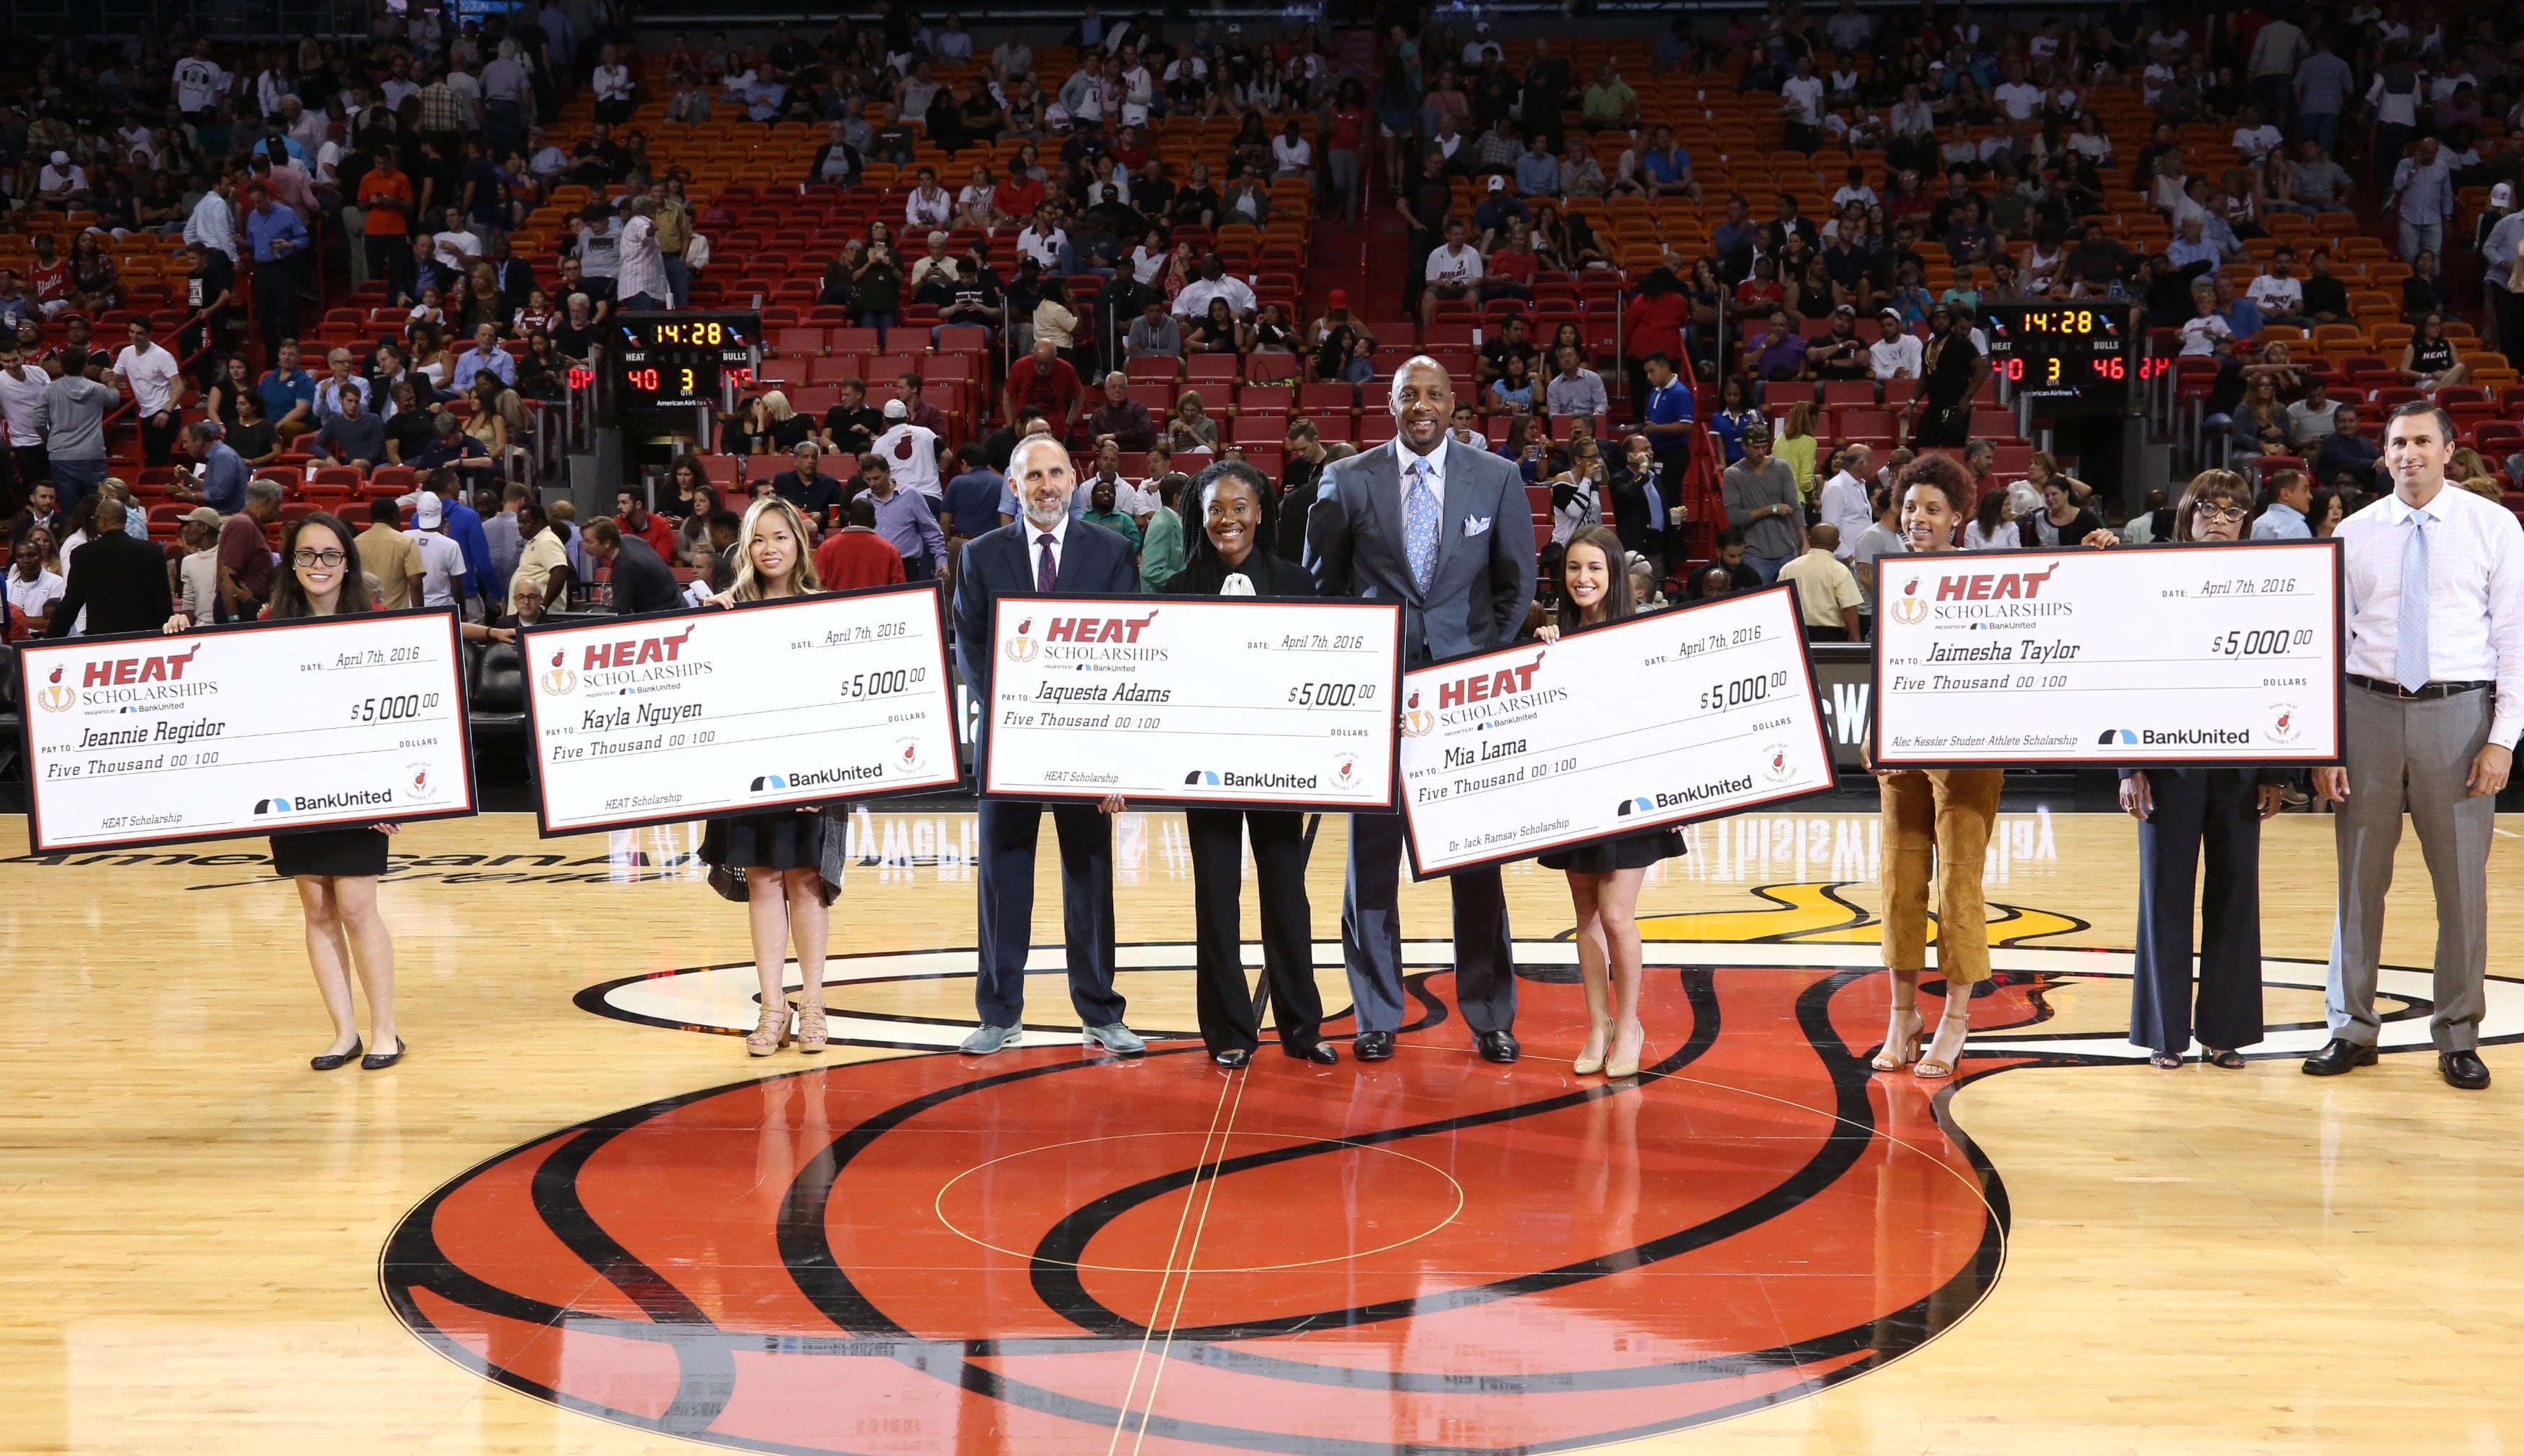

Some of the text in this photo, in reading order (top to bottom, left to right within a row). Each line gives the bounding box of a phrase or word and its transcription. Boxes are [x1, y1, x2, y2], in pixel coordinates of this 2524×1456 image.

[37, 276, 63, 296] Bulls
[2025, 311, 2092, 333] 14:28
[657, 323, 721, 345] 14:28
[2094, 341, 2119, 350] BULLS
[2423, 350, 2448, 360] HEAT
[628, 369, 658, 391] 40
[681, 369, 693, 390] 3
[2048, 358, 2060, 380] 3
[2092, 358, 2125, 380] 46
[1935, 561, 2059, 601] HEAT
[2162, 589, 2188, 598] DATE:
[2200, 580, 2232, 597] April
[2261, 578, 2296, 593] 2016
[1935, 602, 2073, 619] SCHOLARSHIPS
[791, 640, 814, 650] DATE:
[825, 628, 851, 645] April
[877, 622, 906, 638] 2016
[1045, 609, 1159, 644] HEAT
[1989, 622, 2036, 630] BankUnited
[583, 622, 695, 671] HEAT
[1281, 634, 1309, 650] April
[1333, 635, 1363, 649] 2016
[1644, 655, 1669, 667] DATE:
[1679, 637, 1704, 658] April
[1732, 625, 1761, 645] 2016
[1925, 640, 2012, 663] Jaimesha
[2020, 639, 2081, 665] Taylor
[300, 663, 324, 672] DATE:
[335, 651, 363, 668] April
[390, 646, 420, 662] 2016
[1045, 646, 1168, 661] SCHOLARSHIPS
[82, 642, 201, 688] HEAT
[584, 661, 713, 688] SCHOLARSHIPS
[1093, 664, 1135, 673] BankUnited
[637, 682, 681, 693] BankUnited
[1439, 650, 1545, 710] HEAT
[1892, 675, 1925, 690] Five
[1933, 674, 2010, 689] Thousand
[2263, 678, 2307, 686] DOLLARS
[82, 681, 218, 706] SCHOLARSHIPS
[1035, 681, 1108, 704] Jaquesta
[1111, 682, 1171, 703] Adams
[138, 701, 184, 712] BankUnited
[581, 706, 630, 732] Kayla
[636, 702, 702, 727] Nguyen
[888, 711, 925, 723] DOLLARS
[1440, 687, 1568, 727] SCHOLARSHIPS
[1003, 711, 1034, 726] Five
[1040, 712, 1110, 728] Thousand
[1494, 711, 1538, 727] BankUnited
[1753, 717, 1792, 732] DOLLARS
[60, 744, 75, 752] TO:
[78, 725, 148, 748] Jeannie
[153, 717, 226, 744] Regidor
[399, 737, 437, 748] DOLLARS
[1891, 734, 2078, 747] Alec Kessler Student-Athlete Scholarship
[2143, 729, 2250, 745] BankUnited
[552, 745, 584, 760] Five
[590, 734, 663, 756] Thousand
[47, 763, 81, 778] Five
[88, 754, 164, 775] Thousand
[1409, 739, 1527, 779] PAY TO: Mia Lama
[789, 763, 883, 788] BankUnited
[1044, 770, 1119, 785] HEAT Scholarship
[1224, 772, 1317, 789] BankUnited
[1419, 786, 1448, 802] Five
[1454, 765, 1524, 794] Thousand
[294, 788, 392, 811] BankUnited
[604, 792, 682, 810] HEAT Scholarship
[1656, 774, 1753, 809] BankUnited
[101, 812, 183, 829] HEAT Scholarship
[1449, 819, 1569, 852] Dr. Jack Ramsay Scholarship
